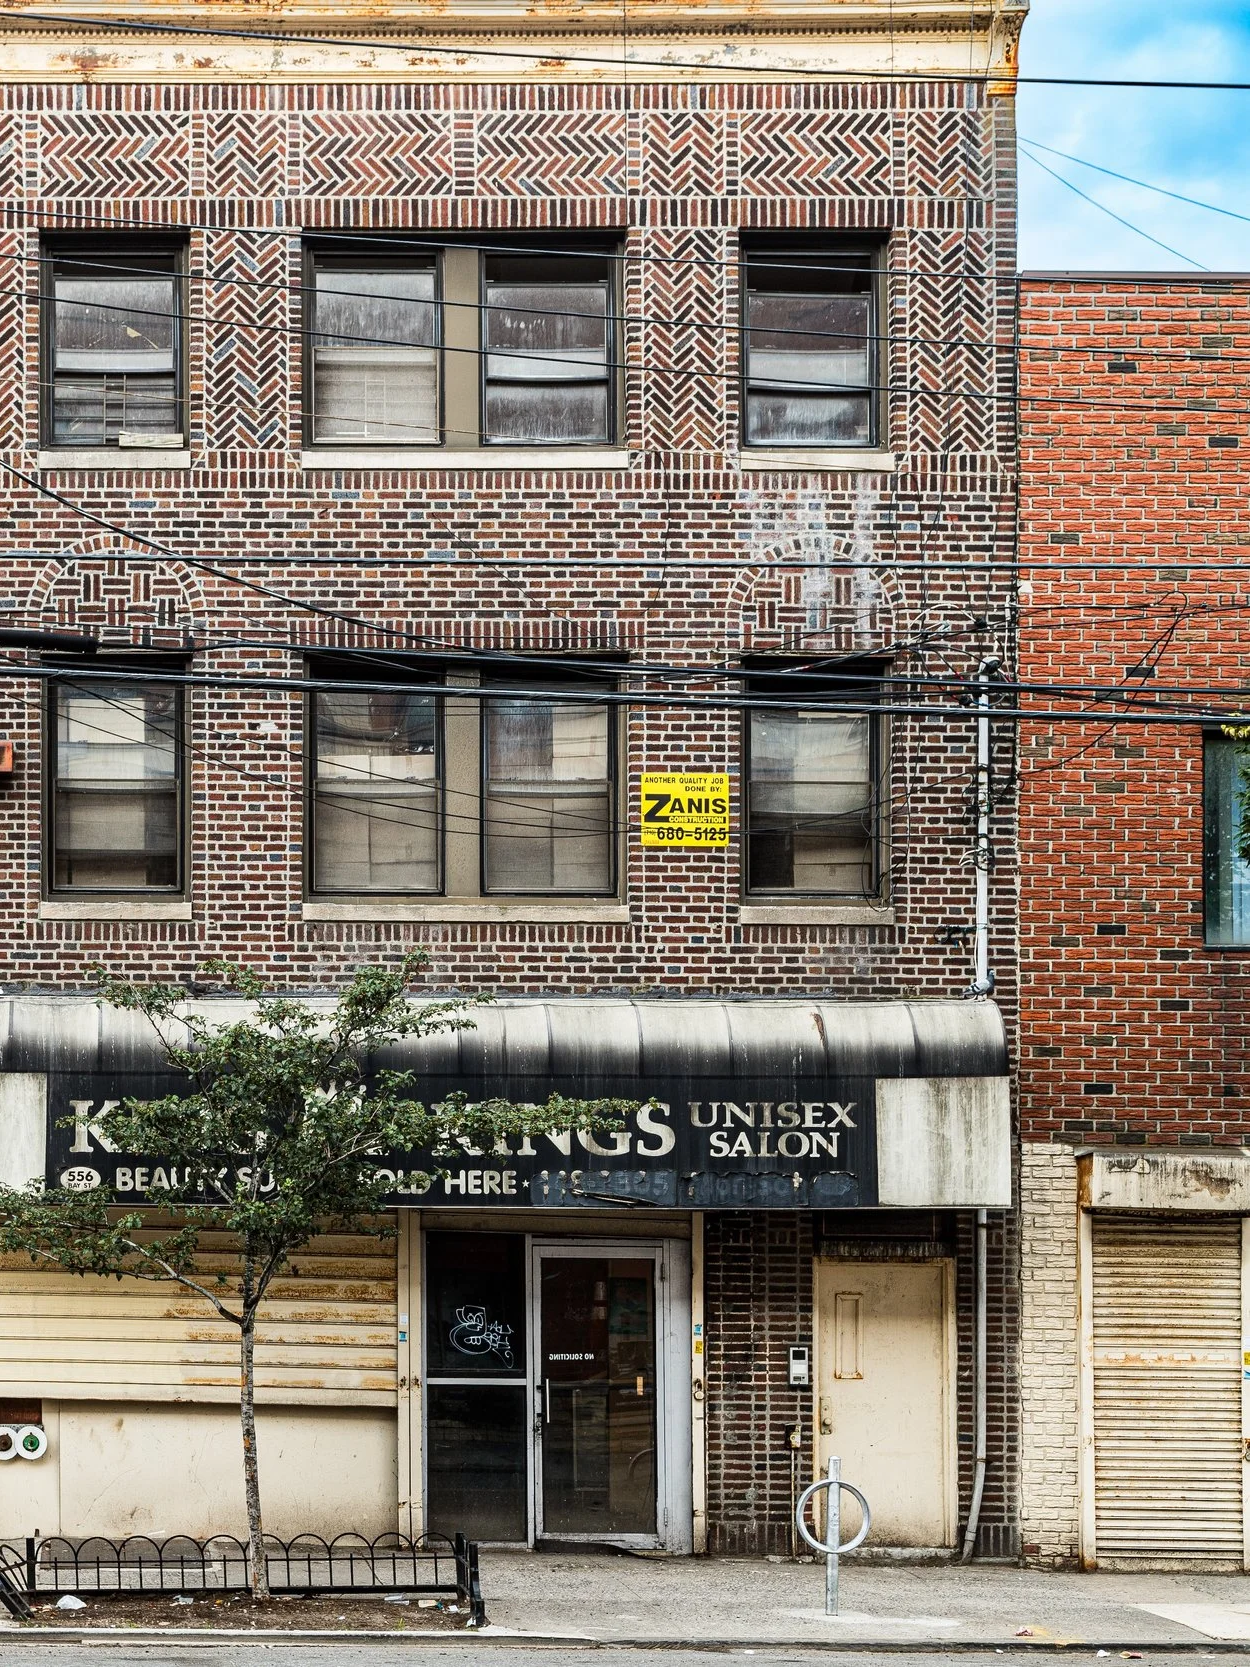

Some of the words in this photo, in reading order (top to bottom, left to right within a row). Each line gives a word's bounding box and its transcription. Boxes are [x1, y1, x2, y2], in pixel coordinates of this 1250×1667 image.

[644, 793, 727, 823] ZANIS
[669, 816, 724, 824] CONSTRUCTION
[657, 826, 727, 841] 680-5125
[687, 1101, 858, 1128] UNISEX
[709, 1130, 841, 1158] SALON
[67, 1170, 94, 1182] 556
[354, 1168, 431, 1194] OLD
[444, 1169, 518, 1195] HERE
